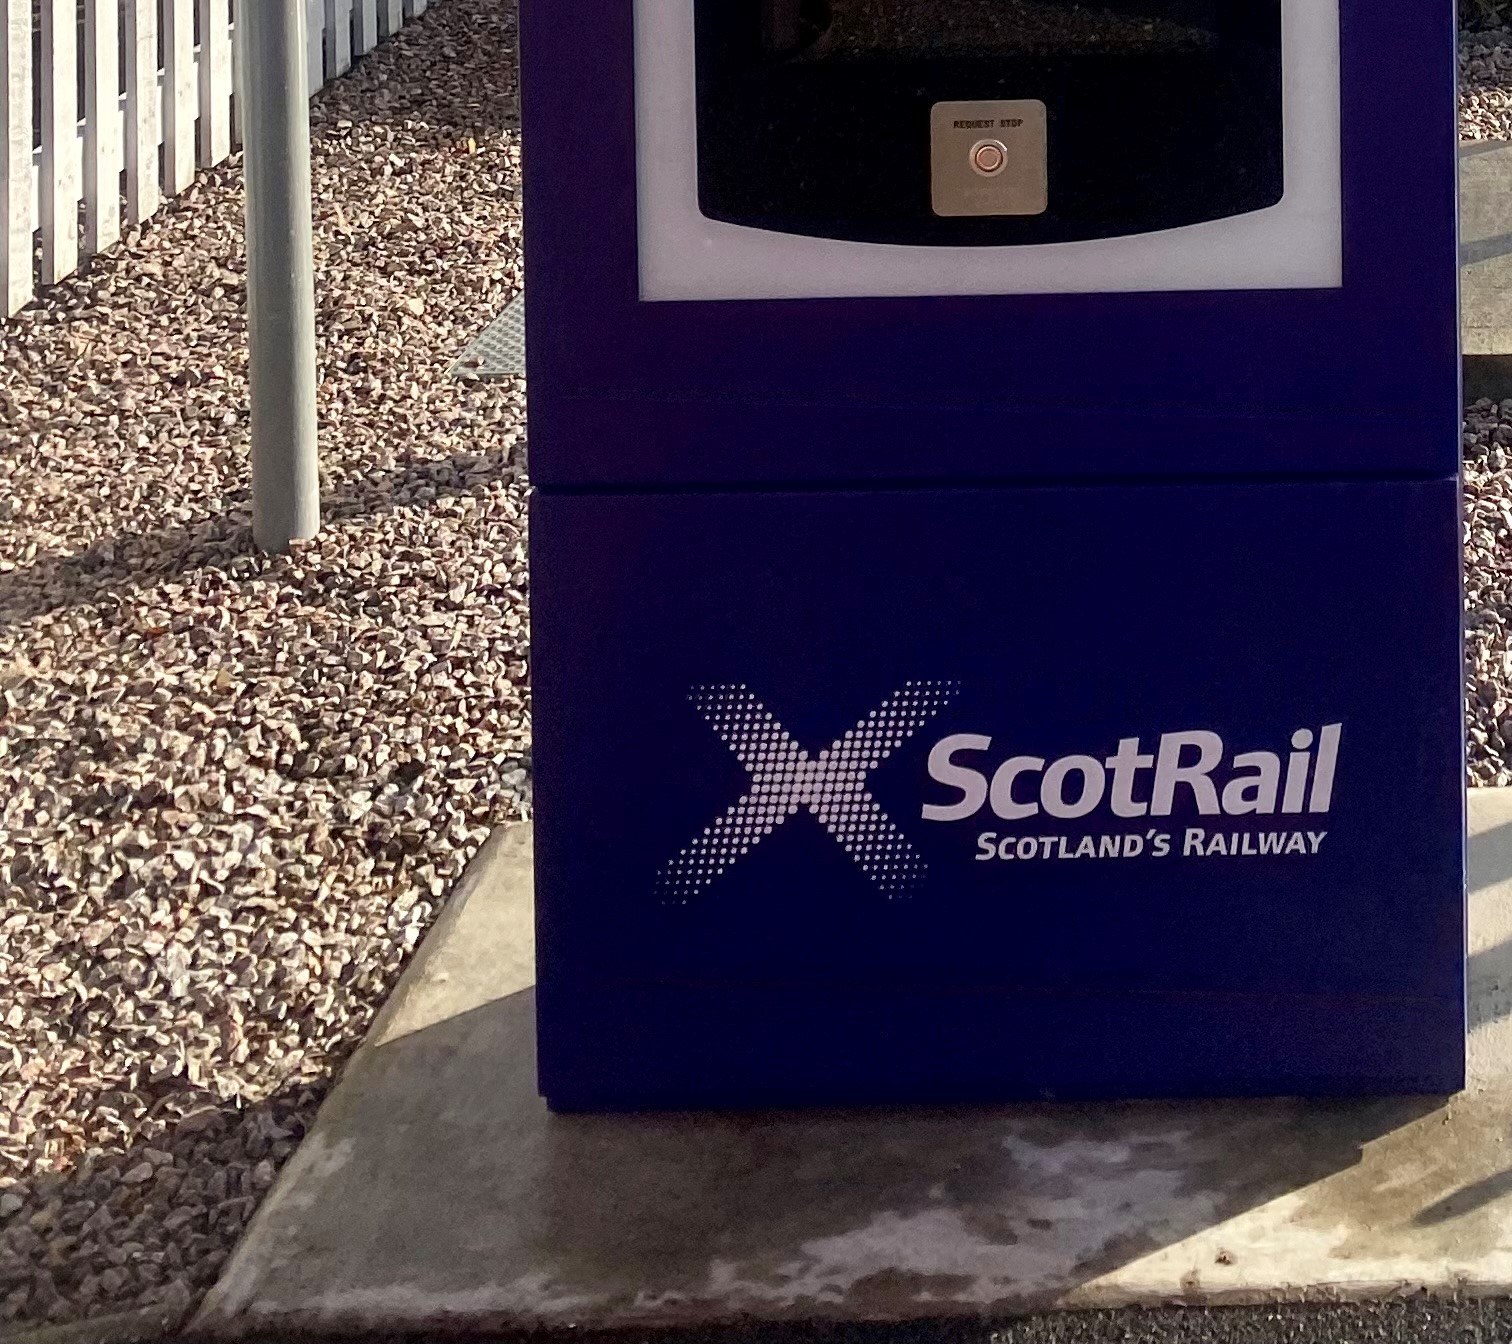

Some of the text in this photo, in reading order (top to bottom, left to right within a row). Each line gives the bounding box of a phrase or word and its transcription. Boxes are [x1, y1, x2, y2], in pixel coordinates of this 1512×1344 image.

[953, 118, 1024, 129] REQUEST STOP
[919, 721, 1342, 821] ScotRail
[975, 828, 1327, 860] SCOTLAND'S RAILWAY
